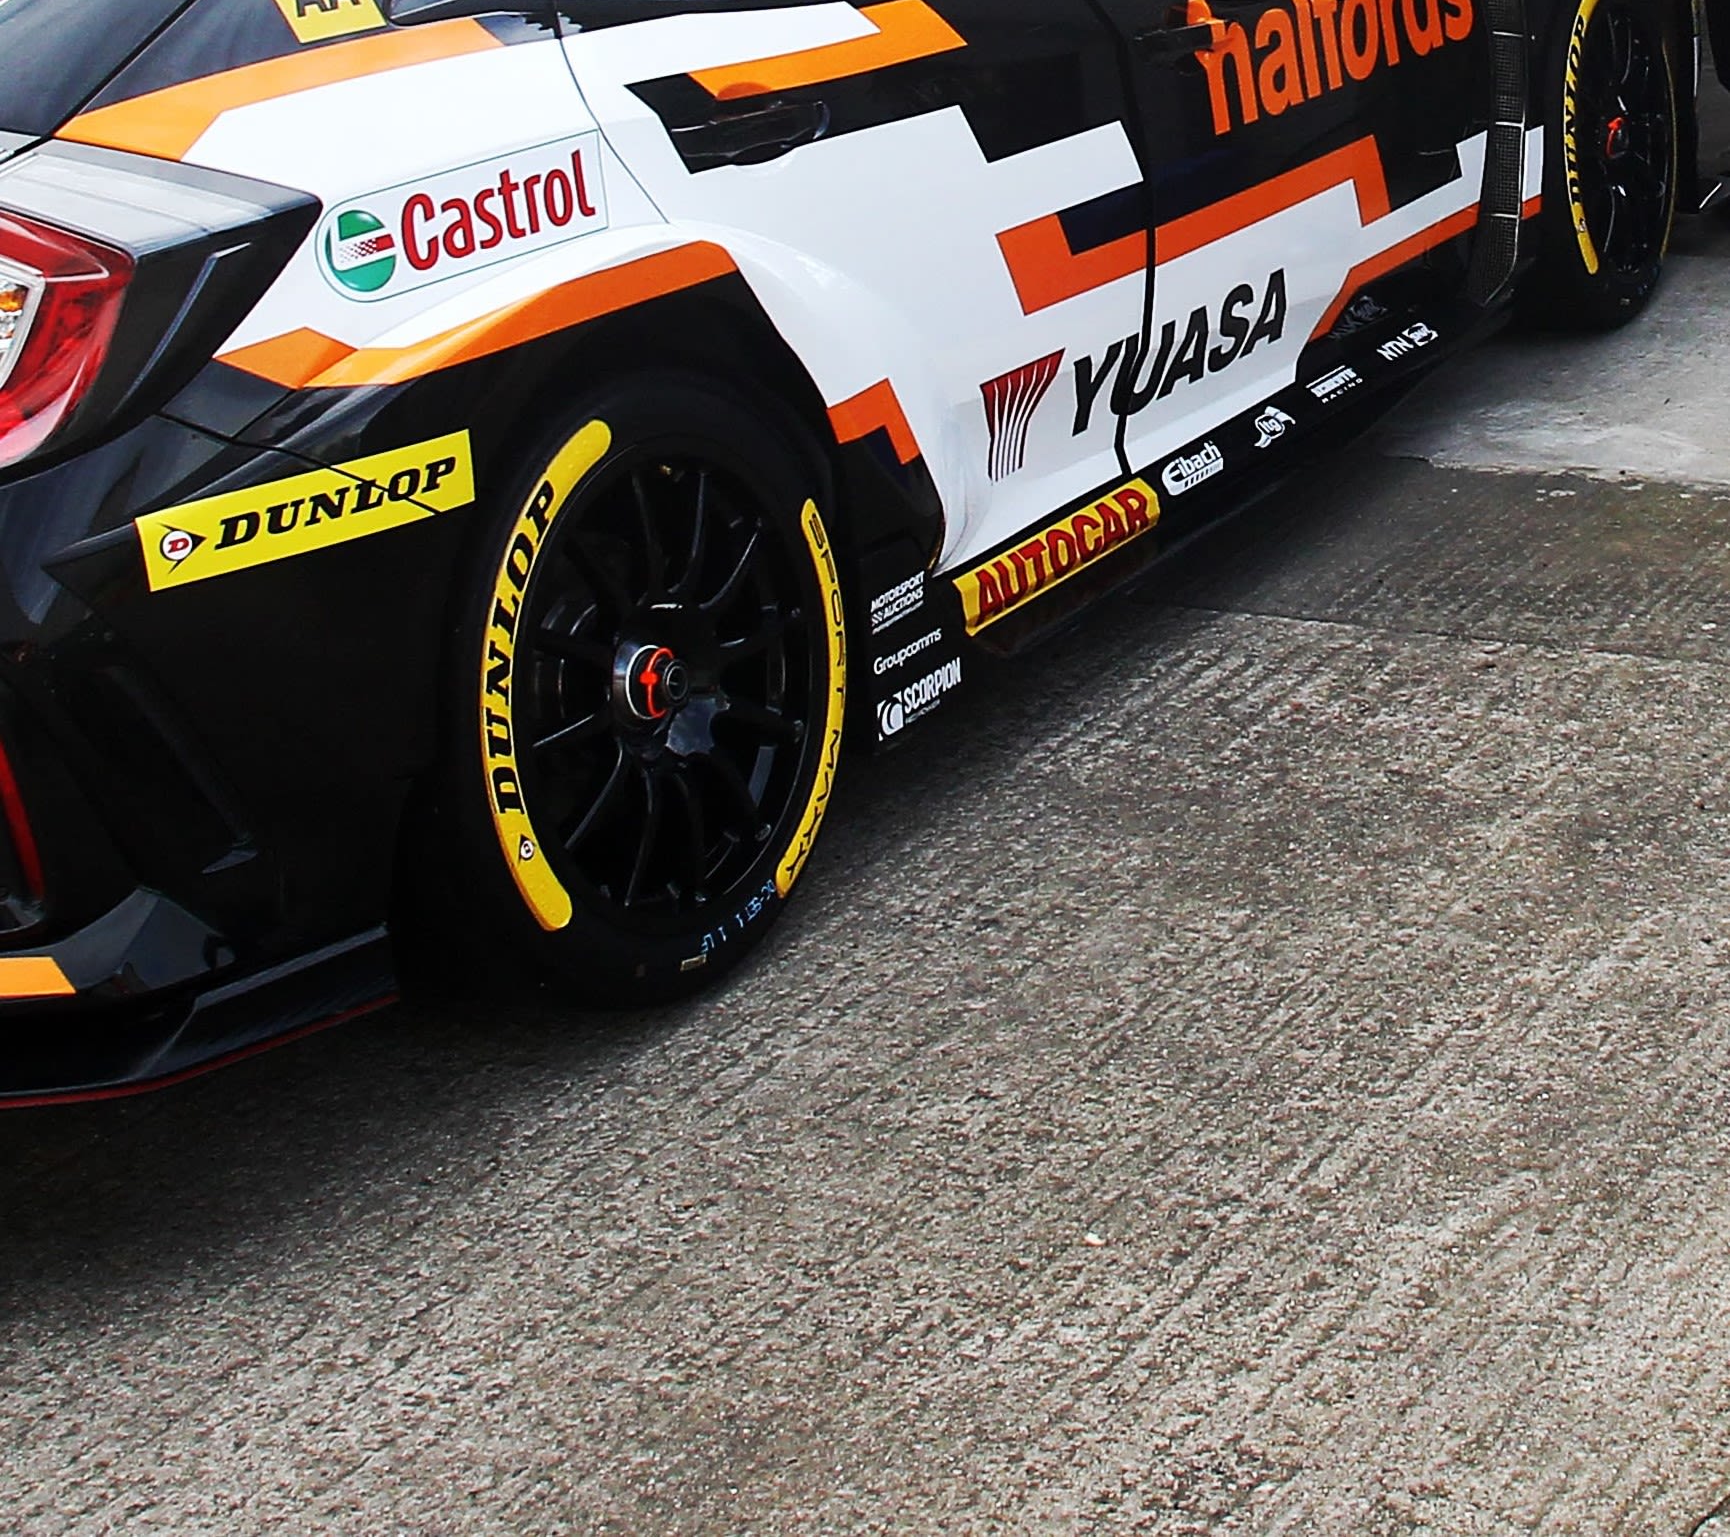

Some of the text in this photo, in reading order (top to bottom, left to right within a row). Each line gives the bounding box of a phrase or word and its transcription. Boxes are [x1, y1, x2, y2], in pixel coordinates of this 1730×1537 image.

[401, 149, 596, 271] Castrol
[1072, 268, 1287, 436] YUASA
[1376, 336, 1414, 361] NTN
[1162, 441, 1222, 485] Eibach
[213, 455, 458, 552] DUNLOP
[976, 488, 1150, 625] AUTOCAR
[871, 571, 925, 612] MOTORSPORT
[883, 586, 924, 619] AUCTIONS
[485, 480, 556, 815] DUNLOP
[874, 628, 942, 675] Groupcomms
[904, 657, 961, 714] SCORPION
